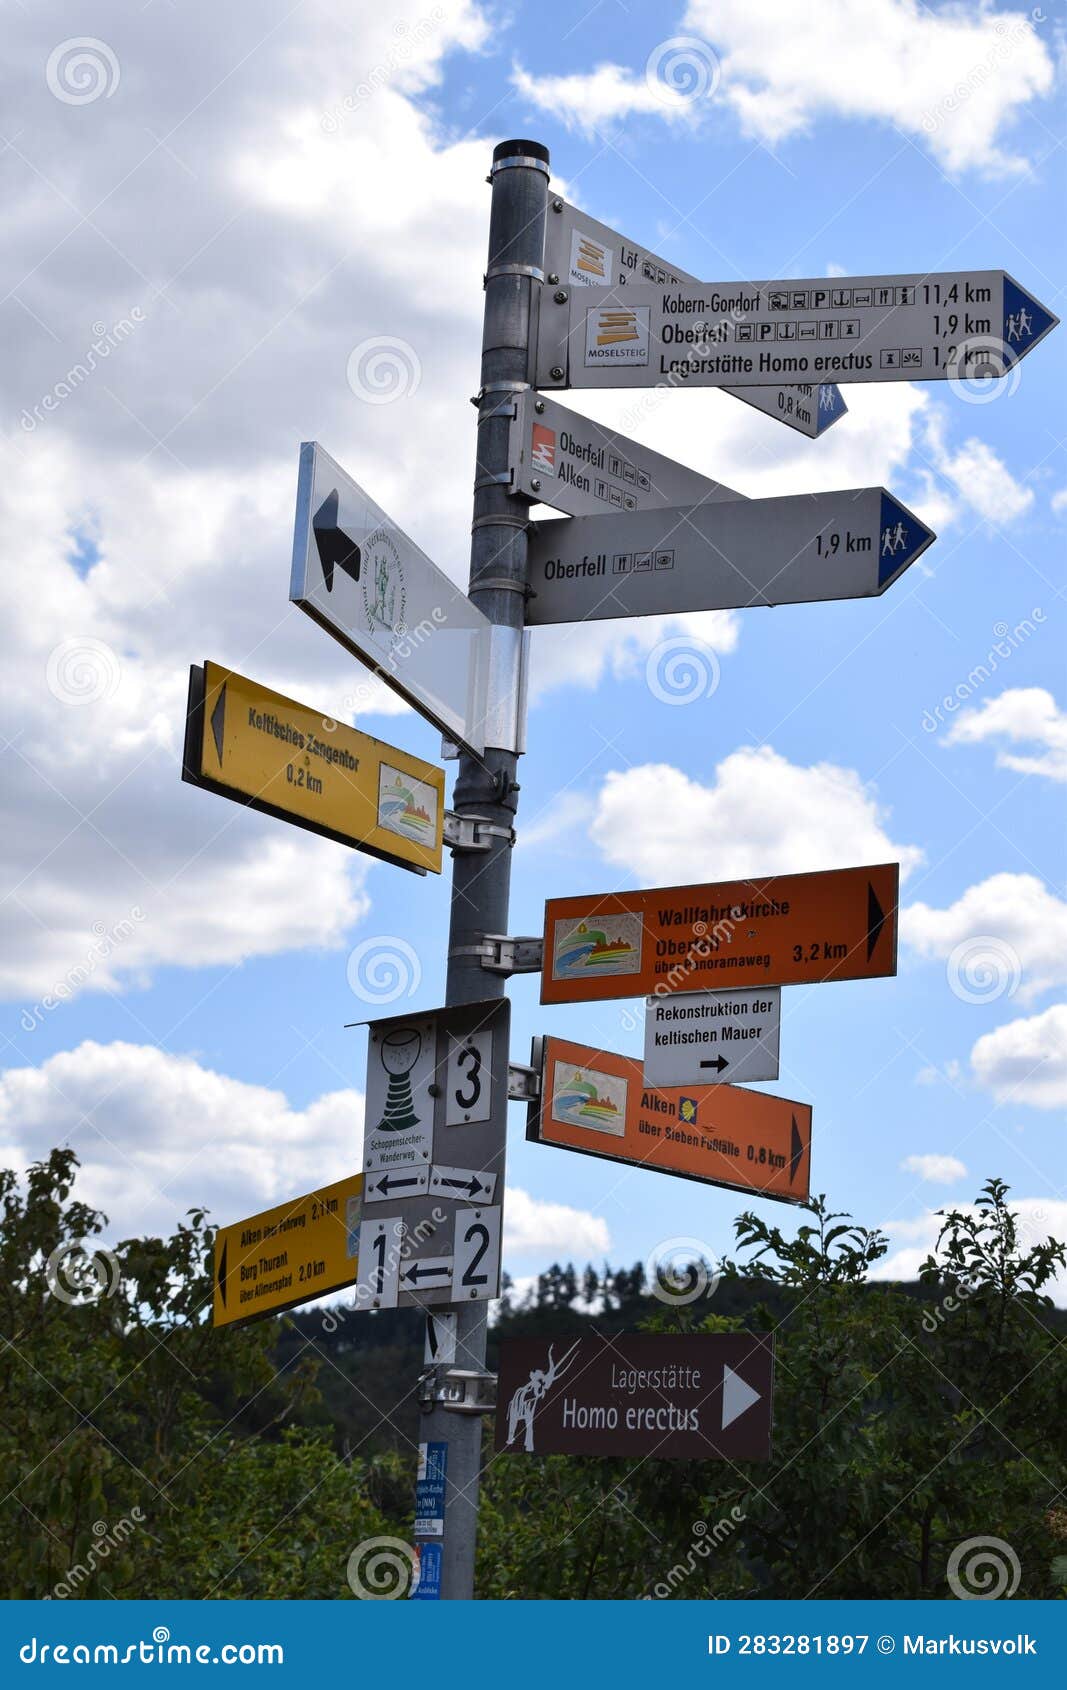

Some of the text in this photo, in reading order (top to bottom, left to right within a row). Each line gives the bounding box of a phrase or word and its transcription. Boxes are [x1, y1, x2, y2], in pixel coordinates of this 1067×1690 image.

[621, 246, 638, 270] Löf
[662, 284, 991, 314] Kobern-Gondorf 11,4 km
[662, 312, 991, 345] Oberfell 1,9 km
[588, 347, 646, 358] MOSELSTEIG
[660, 343, 990, 378] Lagerstätte Homo erectus 1,2 km
[778, 392, 811, 424] 0,8 km
[560, 432, 605, 470] Oberfell
[558, 461, 590, 492] Alken
[545, 531, 871, 580] Oberfell 1,9 km
[248, 707, 360, 772] Keltisches Zangentor
[286, 764, 323, 795] 0,2 km
[657, 899, 791, 927] Wallfahrtskirche
[656, 934, 848, 964] Oberfell 3,2 km
[684, 954, 771, 971] Panoramaweg
[656, 1000, 774, 1023] Rekonstruktion der
[654, 1025, 762, 1046] keltischen Mauer
[455, 1047, 482, 1109] 3
[640, 1092, 676, 1116] Alken
[639, 1121, 662, 1138] über
[665, 1127, 699, 1147] Sieben
[747, 1144, 766, 1166] 0,8
[768, 1150, 786, 1169] km
[240, 1251, 288, 1282] Burg Thurant
[313, 1260, 325, 1276] km
[373, 1233, 387, 1294] 1
[462, 1222, 490, 1287] 2
[612, 1363, 701, 1394] Lagerstätte
[563, 1398, 699, 1431] Homo erectus
